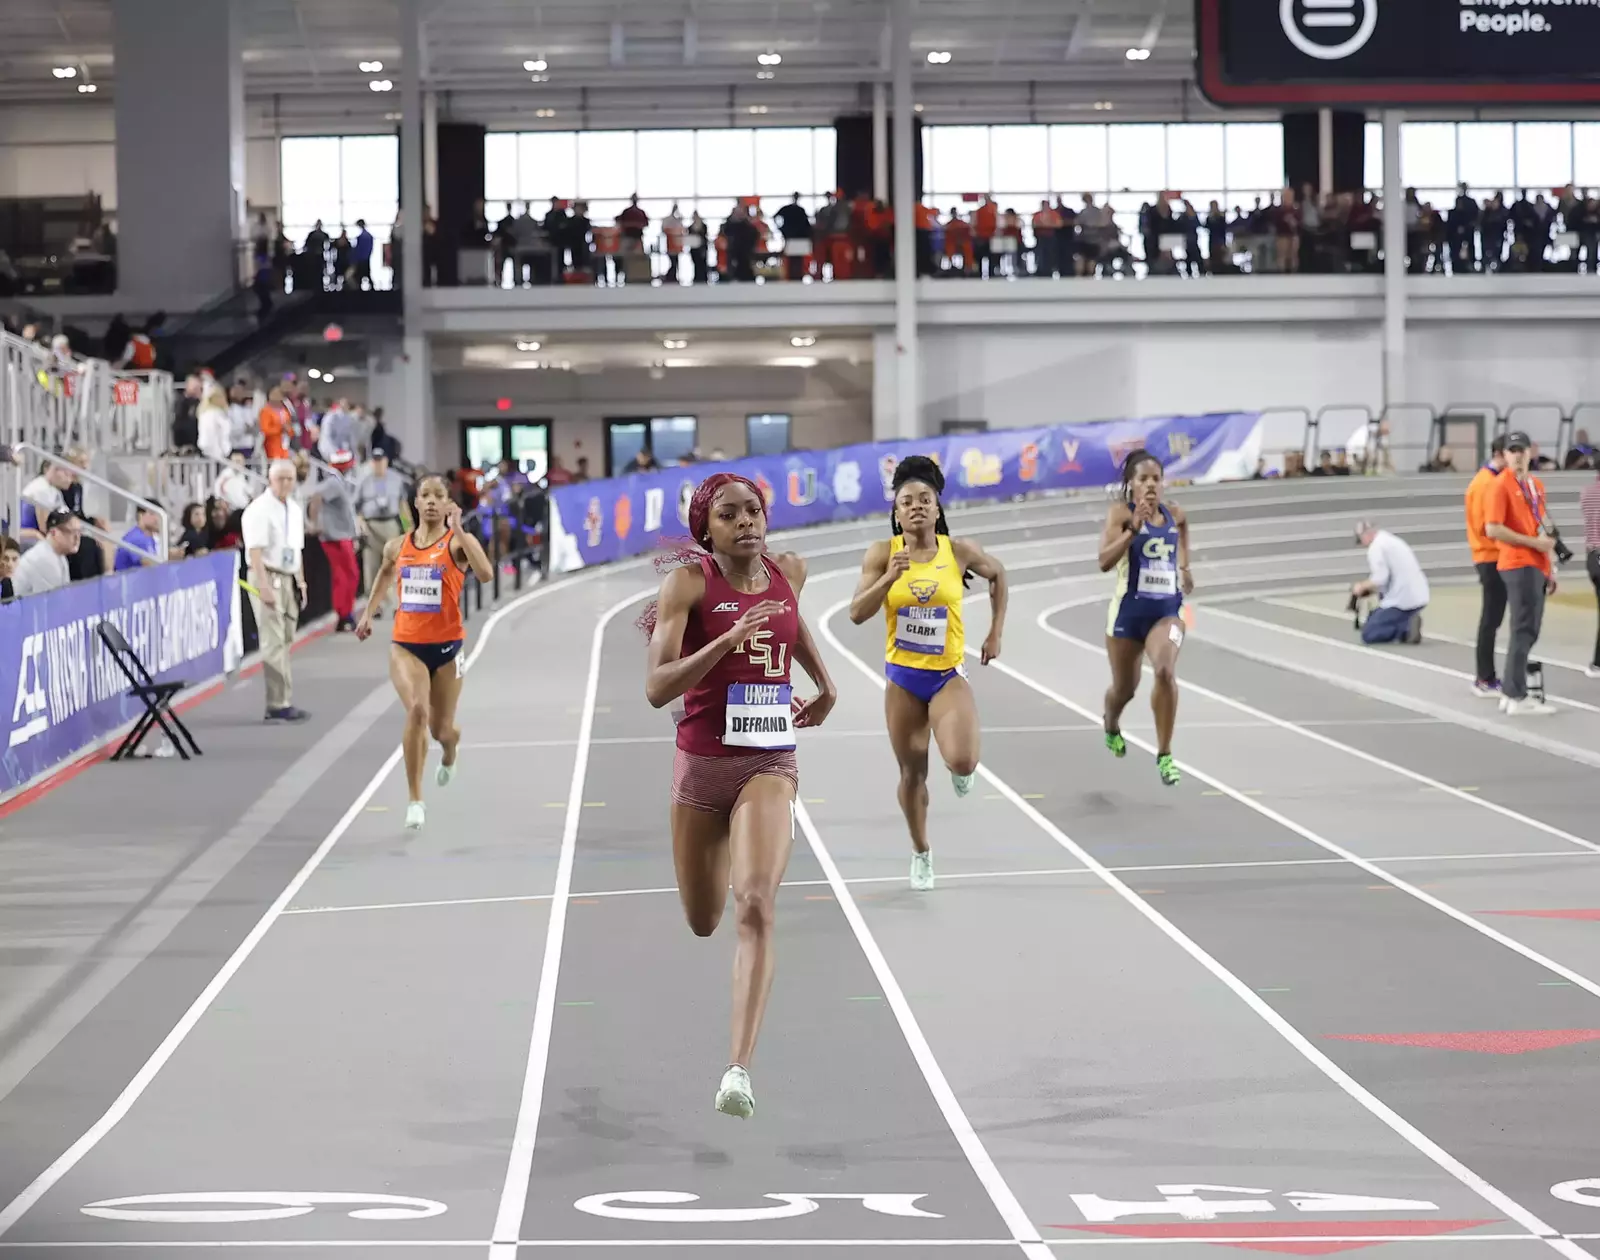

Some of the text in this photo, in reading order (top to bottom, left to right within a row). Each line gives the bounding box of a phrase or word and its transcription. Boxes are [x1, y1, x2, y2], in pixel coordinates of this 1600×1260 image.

[1460, 9, 1552, 36] People.
[711, 602, 740, 613] ACC
[906, 623, 937, 637] CLARK
[744, 684, 781, 705] UNITE
[731, 716, 789, 733] DEFRAND
